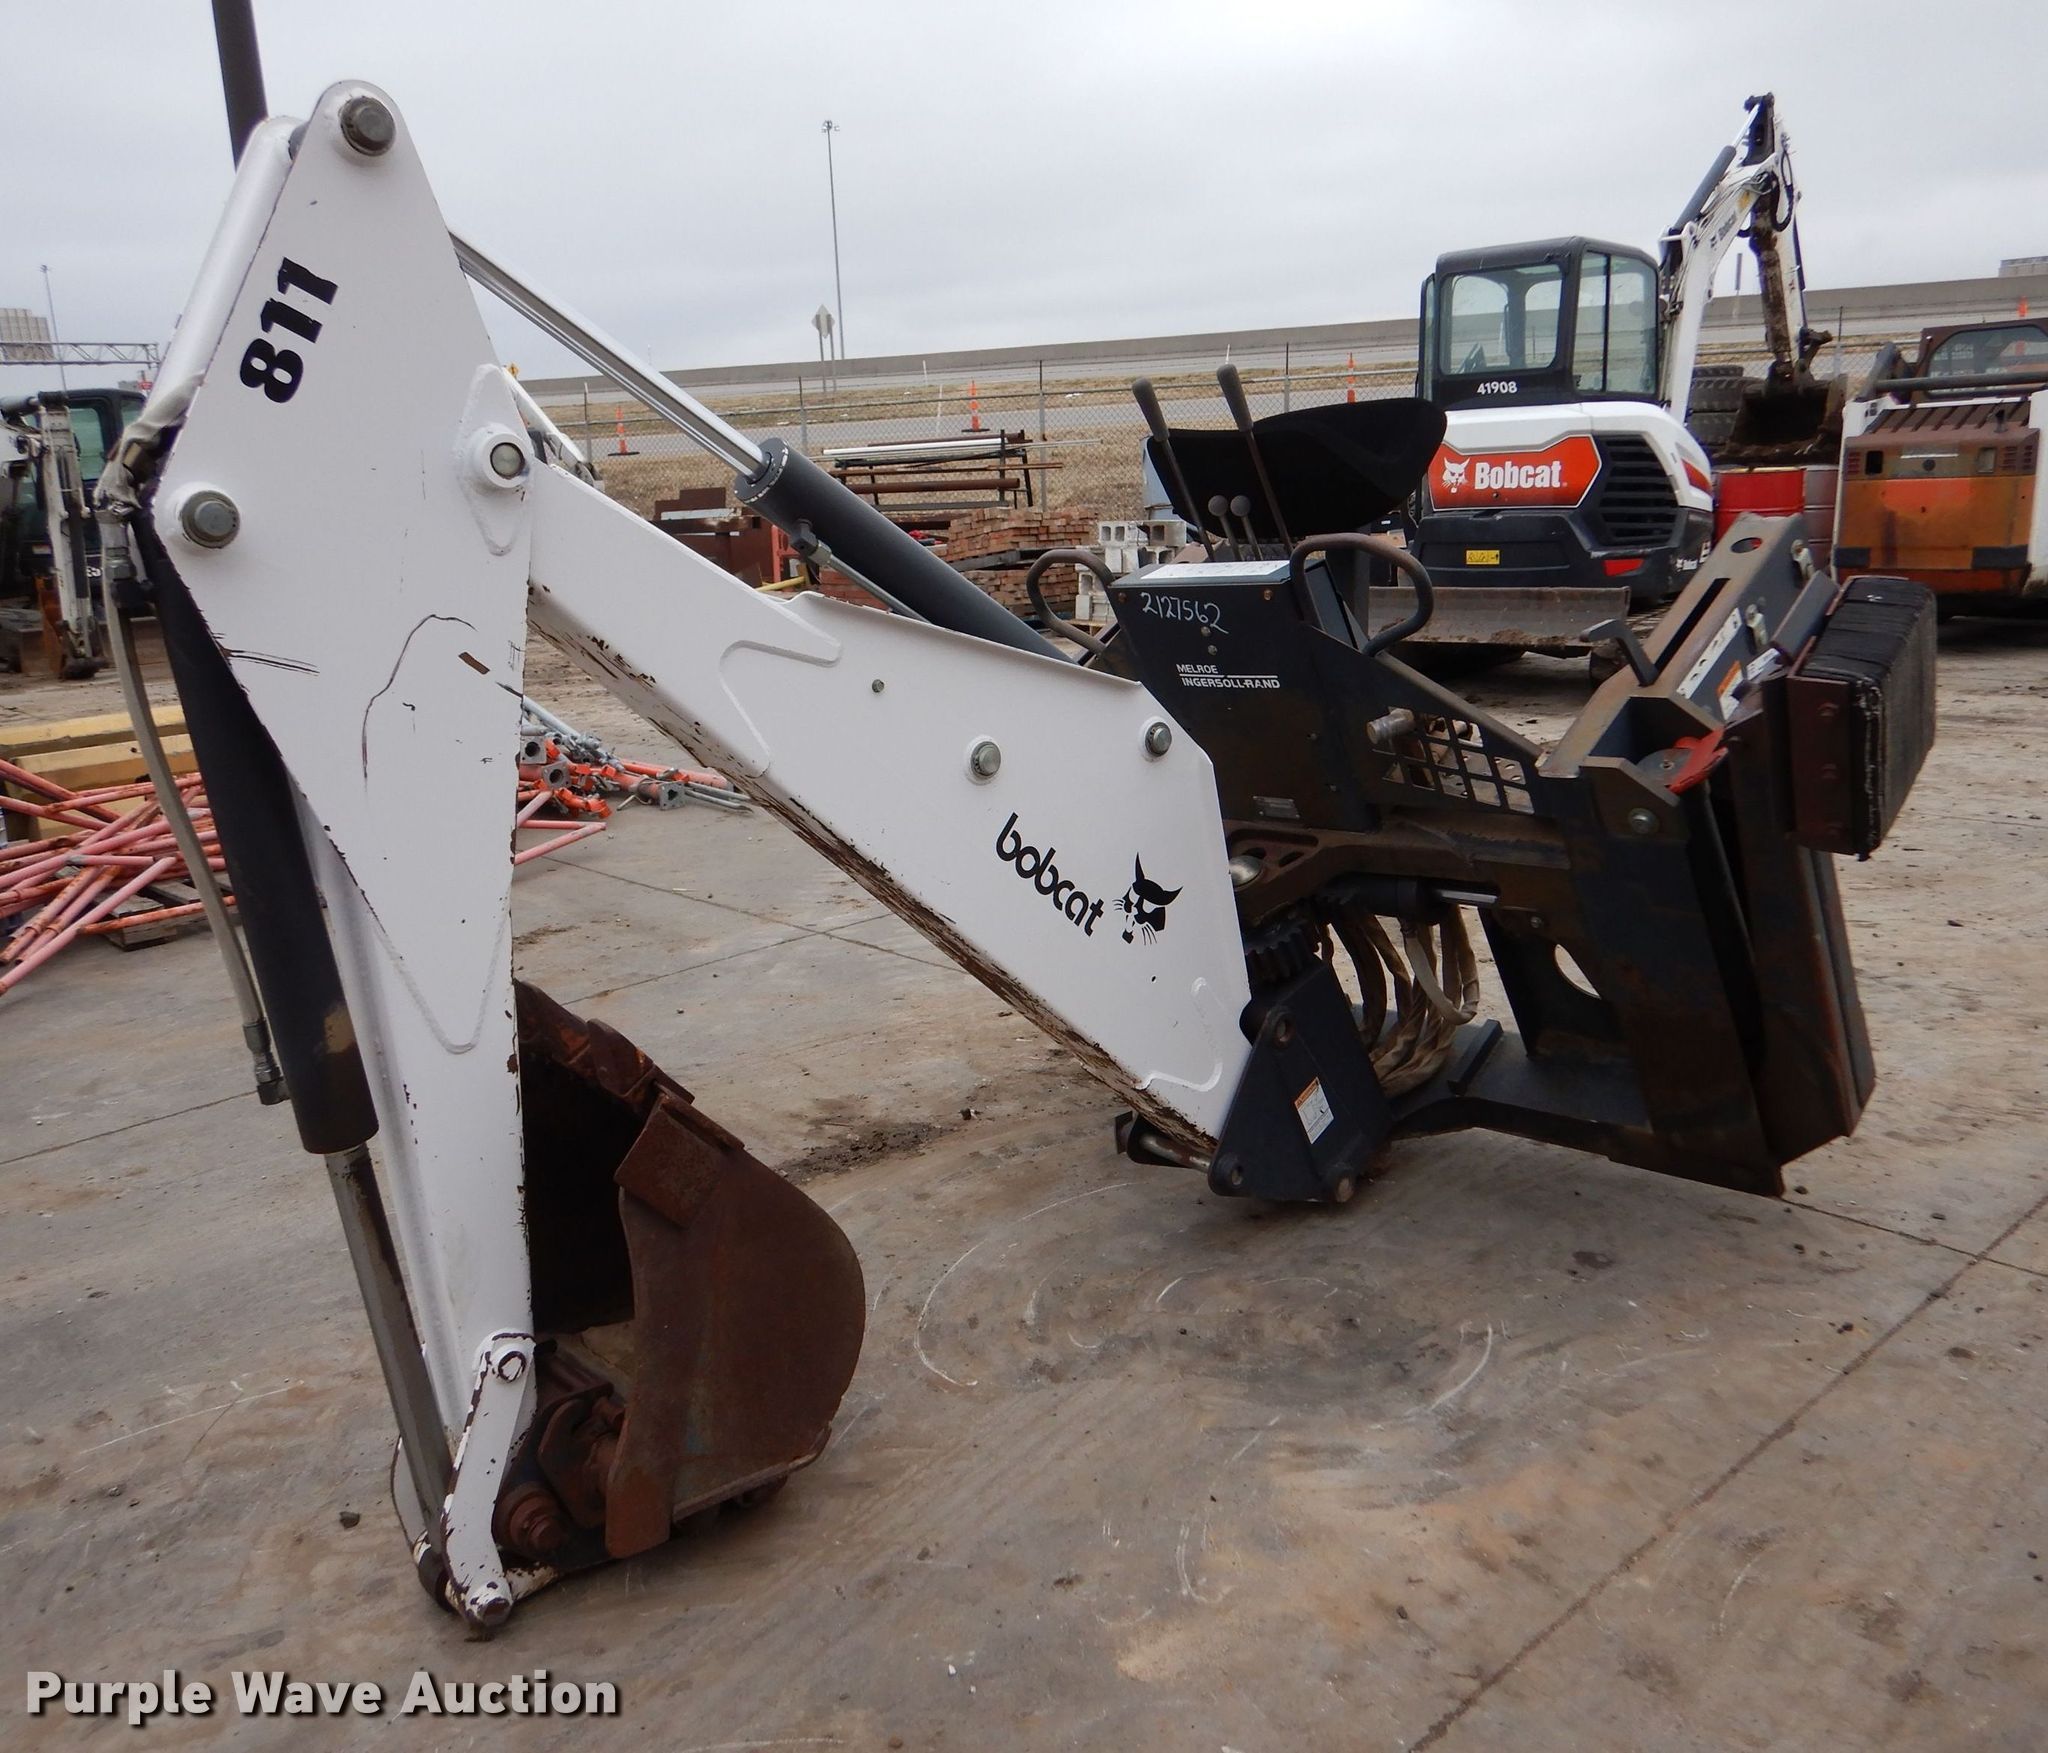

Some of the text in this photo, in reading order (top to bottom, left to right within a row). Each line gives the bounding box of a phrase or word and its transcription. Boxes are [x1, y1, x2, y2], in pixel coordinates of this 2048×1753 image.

[239, 256, 338, 403] 811
[1476, 381, 1518, 395] 41908
[1474, 460, 1562, 490] Bobcat
[1140, 591, 1229, 634] 2127562
[1175, 663, 1219, 674] MELROE
[1181, 677, 1281, 689] INGERSOLL-RAND
[995, 812, 1105, 937] bobcat
